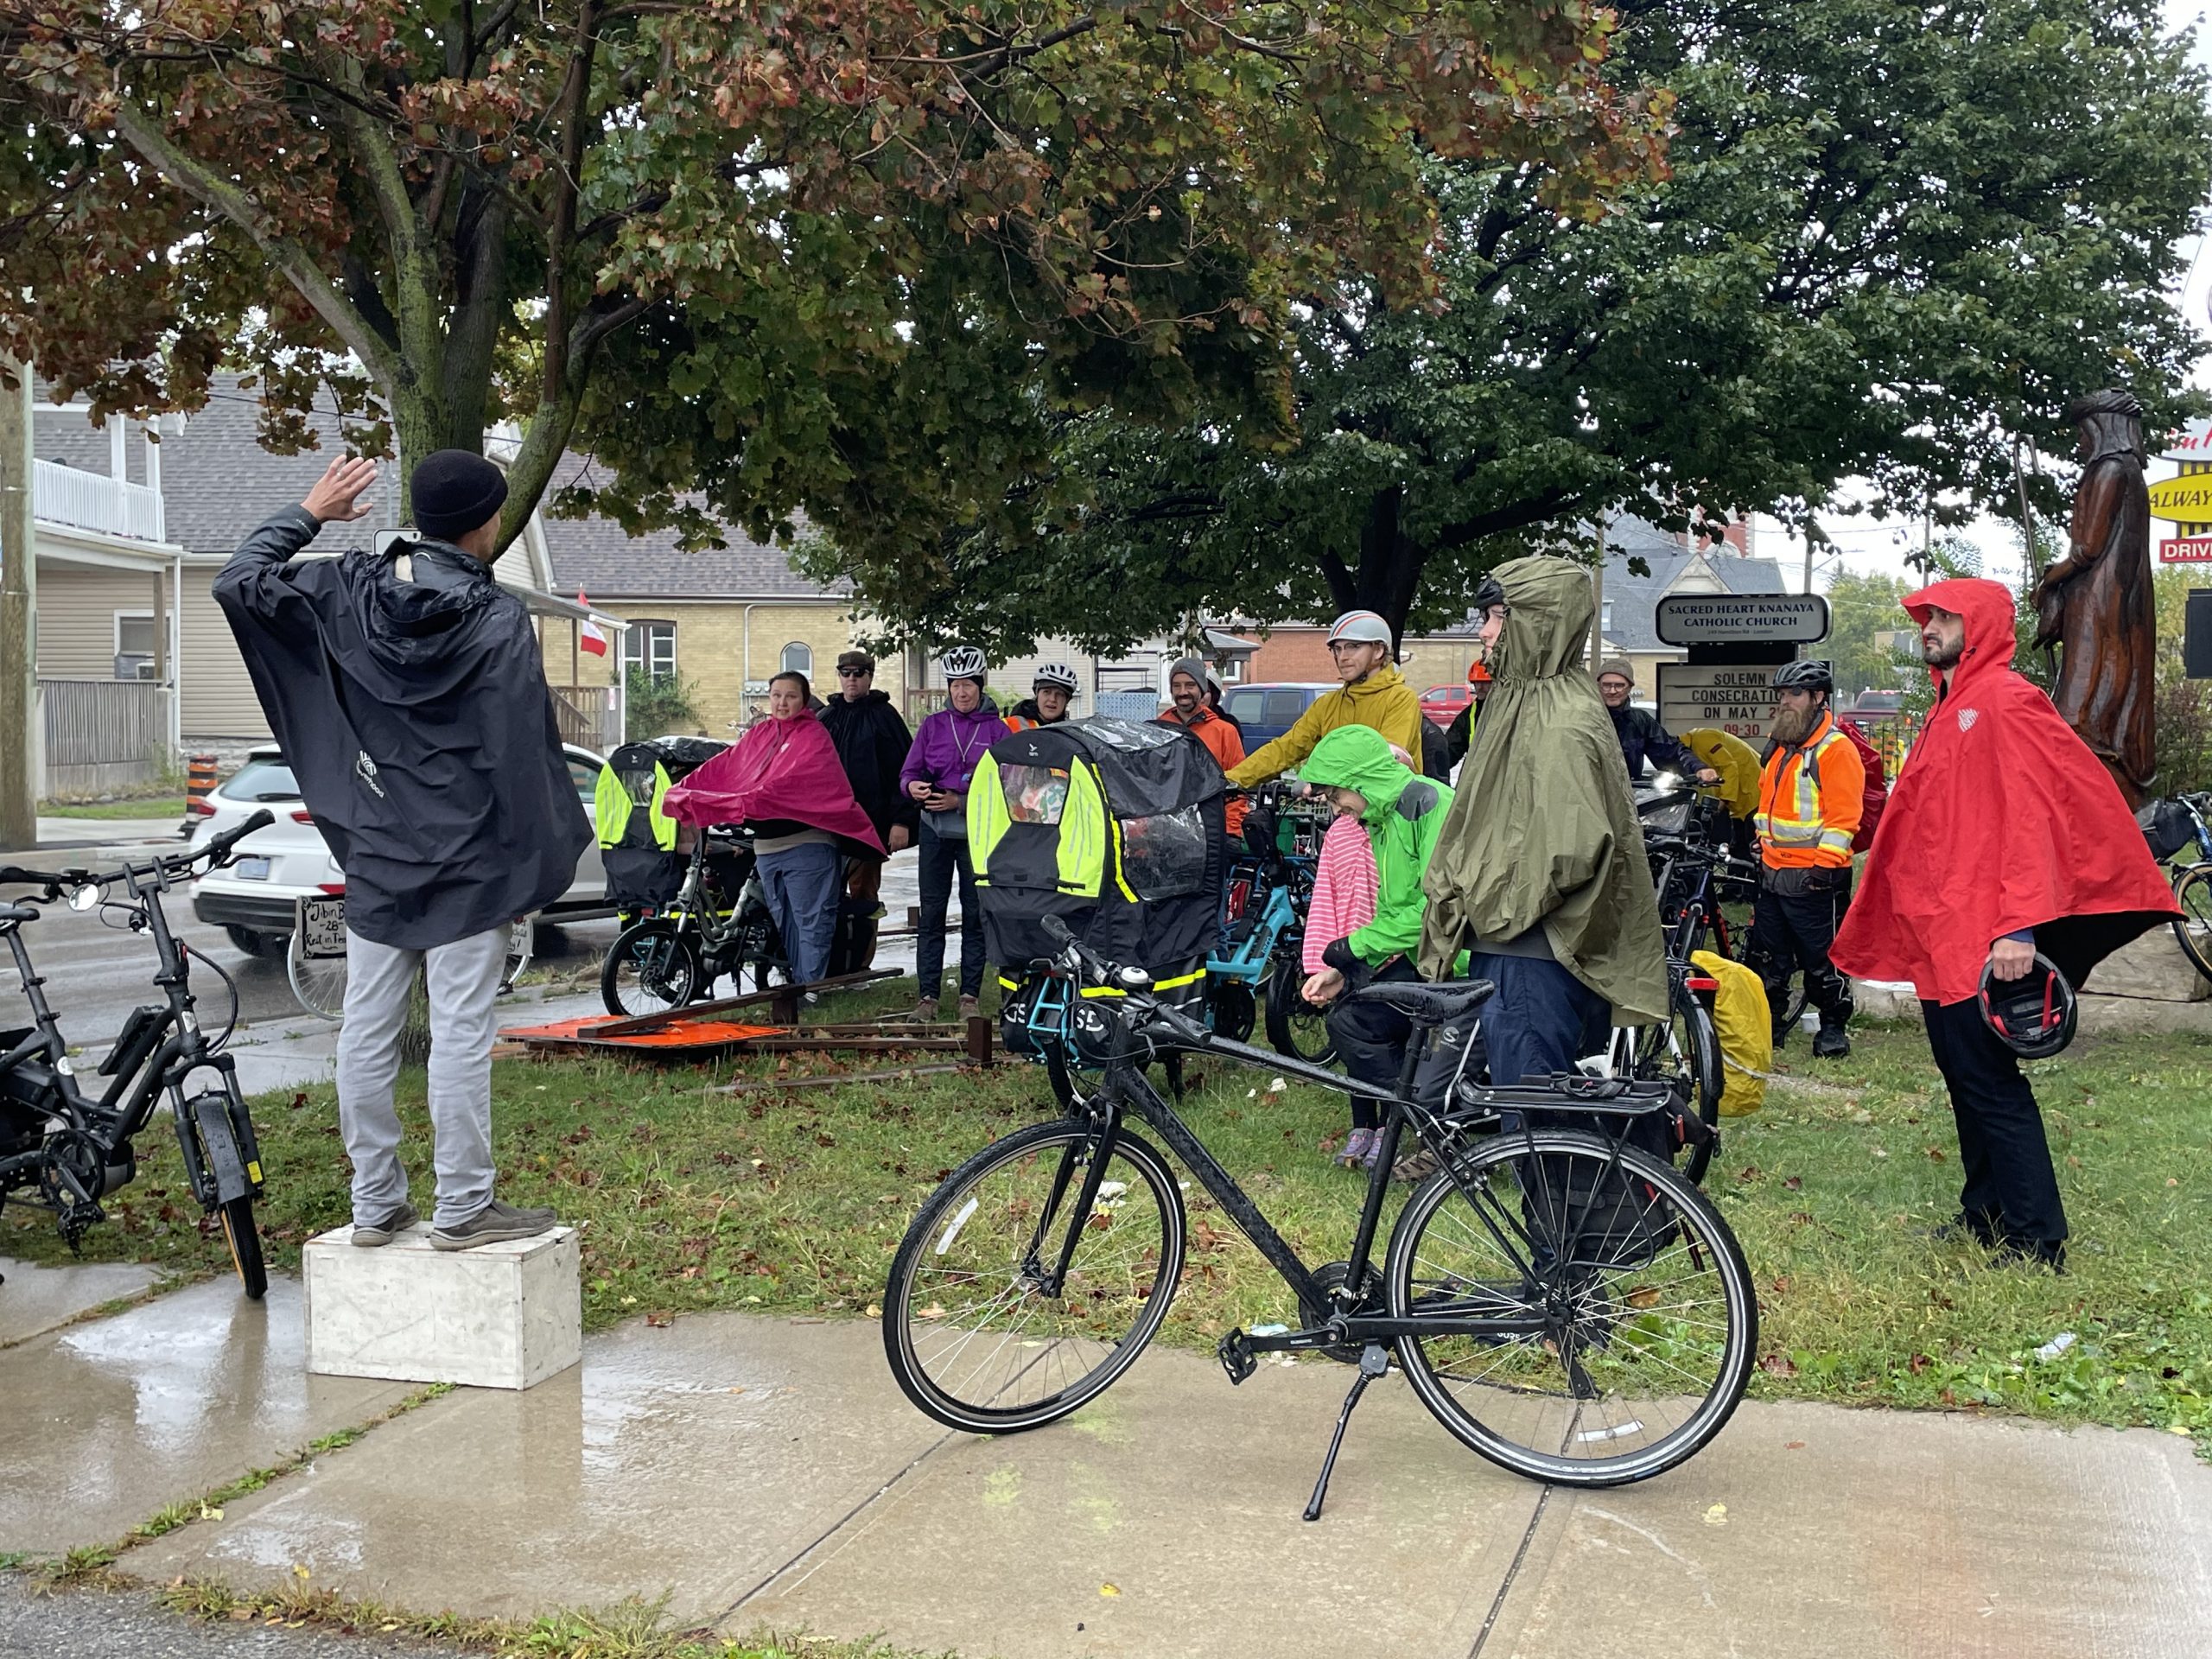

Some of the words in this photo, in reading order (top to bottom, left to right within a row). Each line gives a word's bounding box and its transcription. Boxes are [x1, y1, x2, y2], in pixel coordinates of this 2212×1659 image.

[1669, 606, 1713, 615] SACRED
[1717, 605, 1755, 614] HEART
[1759, 603, 1814, 613] KNANAYA
[1684, 618, 1743, 627] CATHOLIC
[1745, 617, 1797, 626] CHURCH
[1714, 673, 1766, 685] SOLEMN
[1704, 707, 1720, 719] ON
[1729, 707, 1758, 719] MAY
[1770, 707, 1780, 719] 2
[310, 903, 337, 922] Jibin
